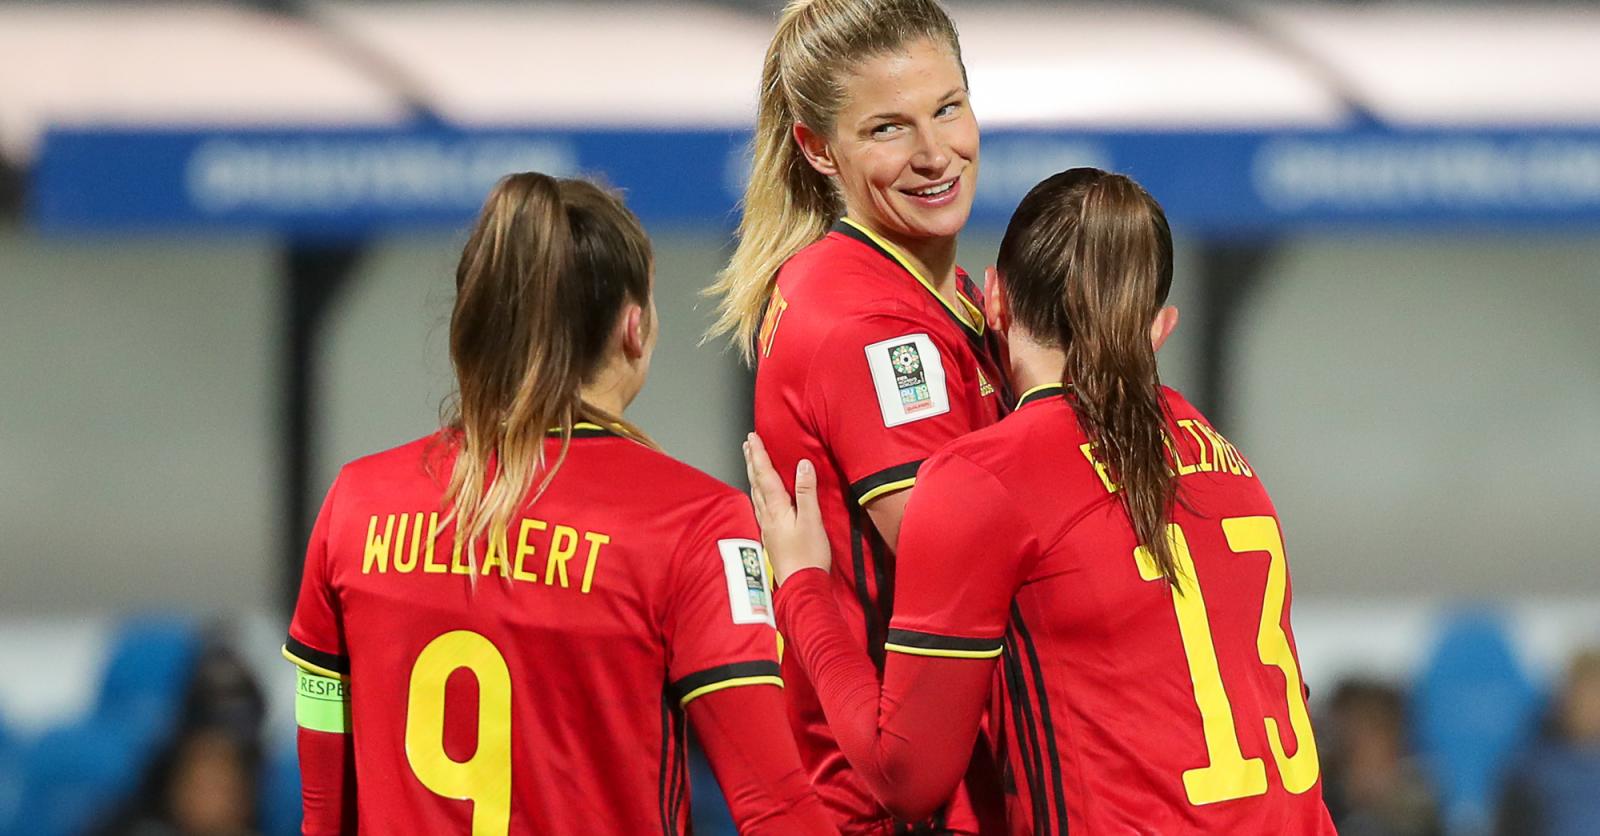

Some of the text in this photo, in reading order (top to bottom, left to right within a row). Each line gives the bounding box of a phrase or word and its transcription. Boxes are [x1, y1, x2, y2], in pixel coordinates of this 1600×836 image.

[1080, 419, 1252, 493] ELINGS
[362, 511, 610, 593] WULLAERT
[1133, 515, 1319, 805] 13
[405, 629, 512, 836] 9
